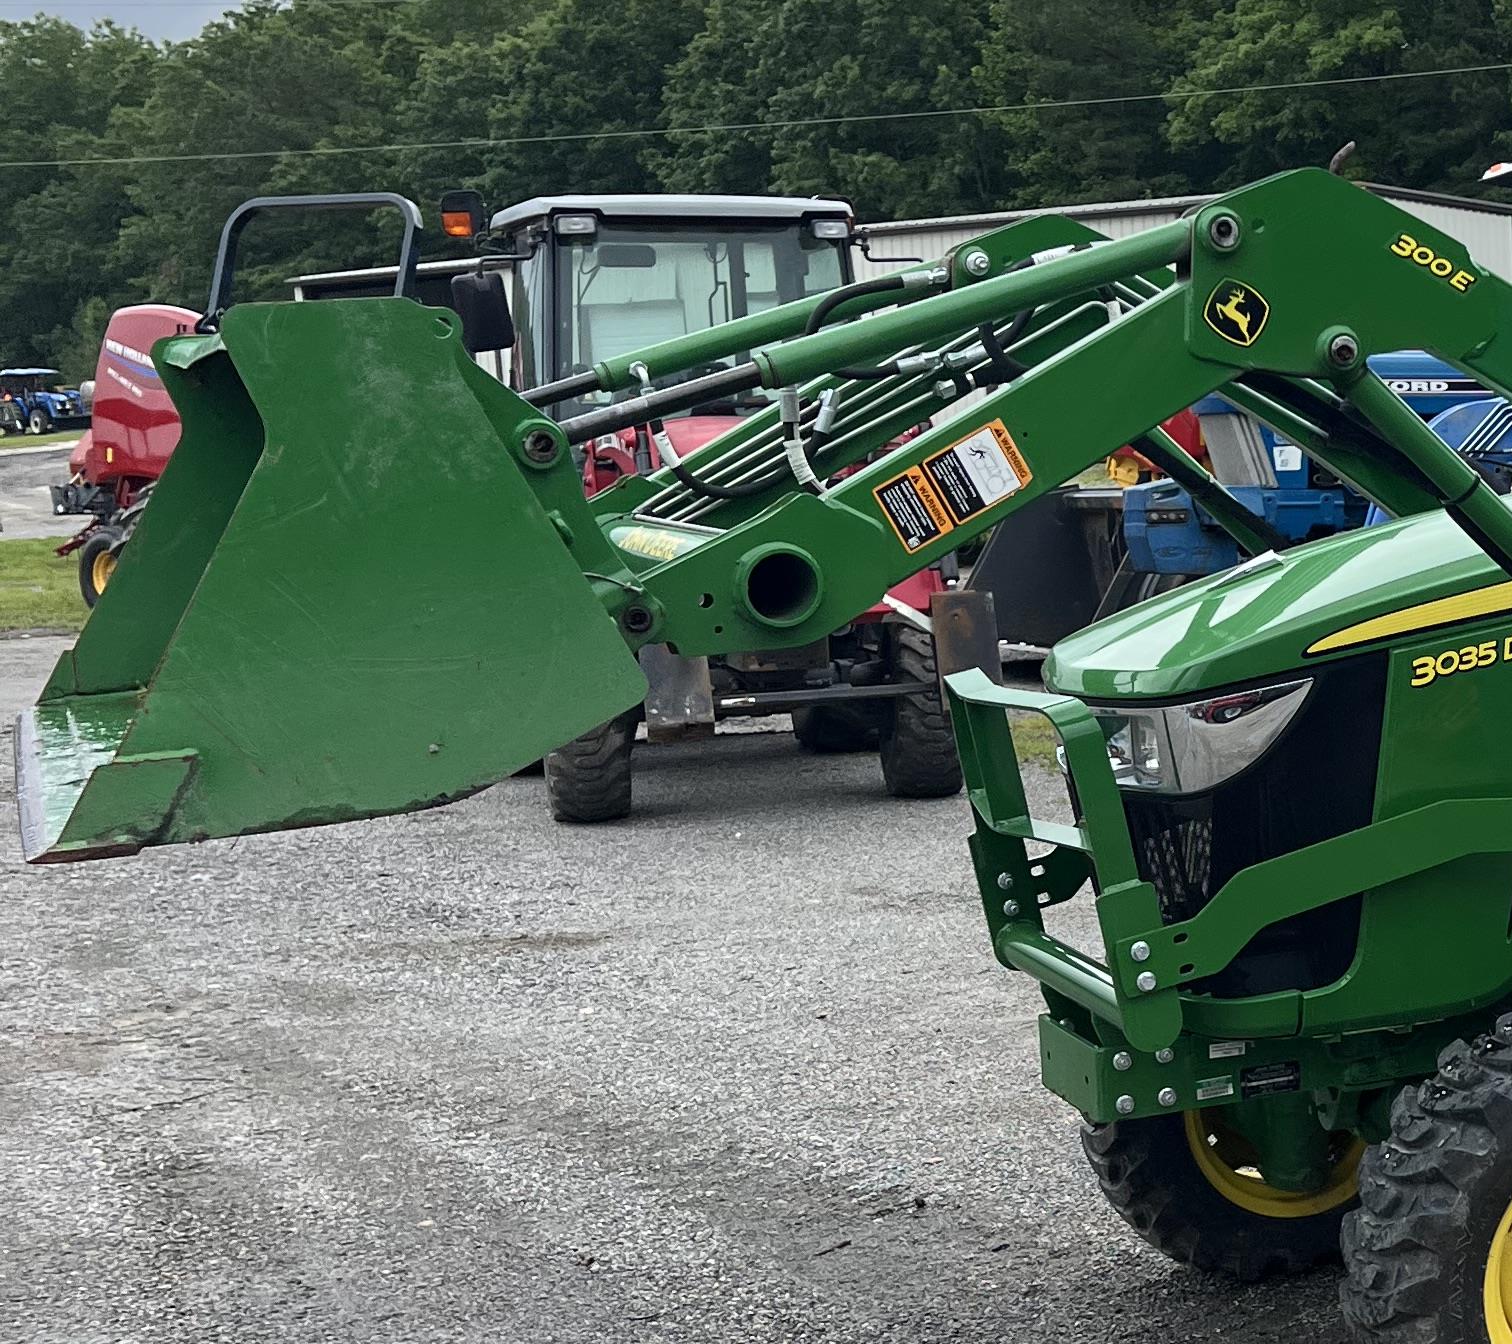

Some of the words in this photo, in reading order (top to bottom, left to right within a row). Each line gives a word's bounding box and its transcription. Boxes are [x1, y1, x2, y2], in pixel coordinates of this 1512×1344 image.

[1390, 233, 1453, 278] 300
[1450, 269, 1476, 292] E
[1385, 381, 1449, 392] ORD
[1001, 437, 1028, 479] WARNING
[919, 485, 947, 527] WARNING
[1410, 640, 1498, 688] 3035
